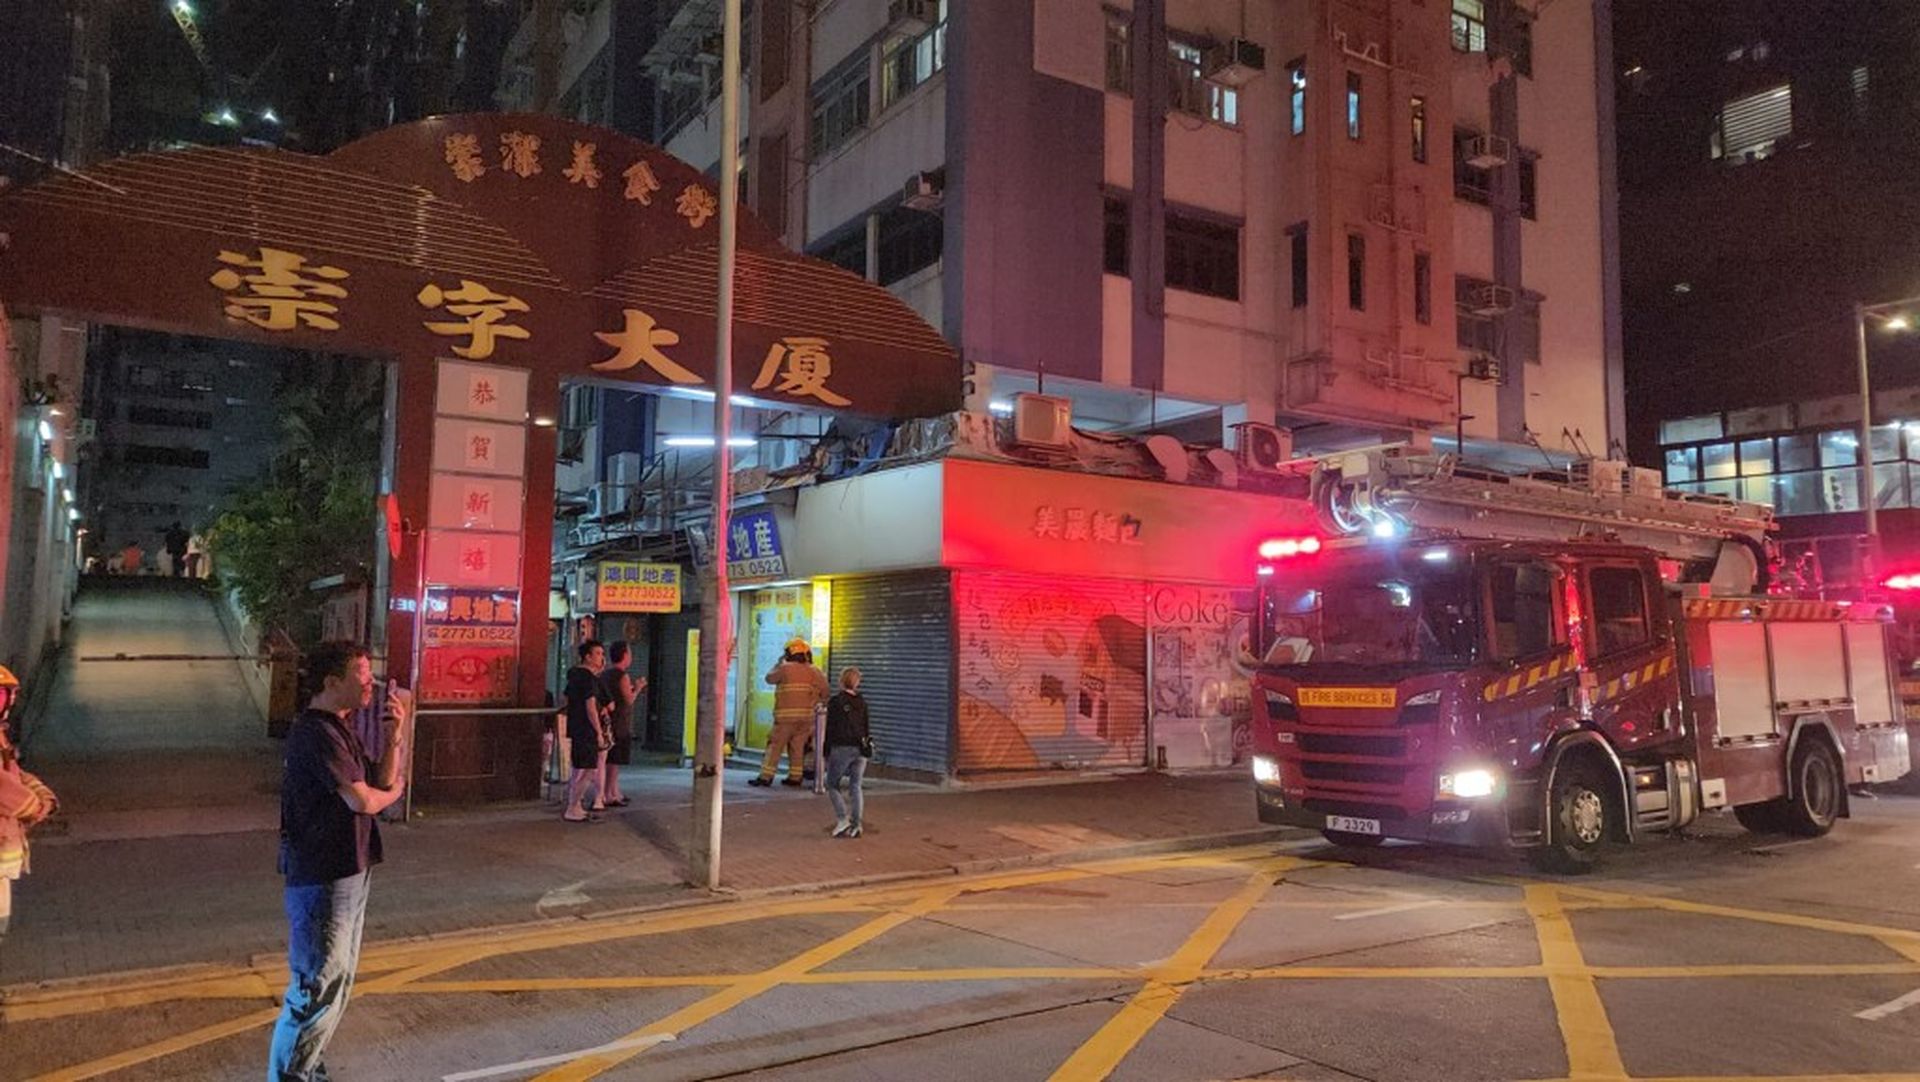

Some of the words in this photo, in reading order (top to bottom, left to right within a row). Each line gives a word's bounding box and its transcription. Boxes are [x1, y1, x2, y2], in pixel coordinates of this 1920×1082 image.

[462, 380, 496, 572] 恭賀新禧
[749, 559, 781, 574] 0522
[621, 587, 676, 599] 27730522
[1154, 588, 1228, 624] Coke
[442, 627, 476, 639] 2773
[480, 628, 514, 640] 0522
[1311, 691, 1331, 703] FIRE
[1333, 691, 1377, 704] SERVICES
[1344, 819, 1374, 832] 2329
